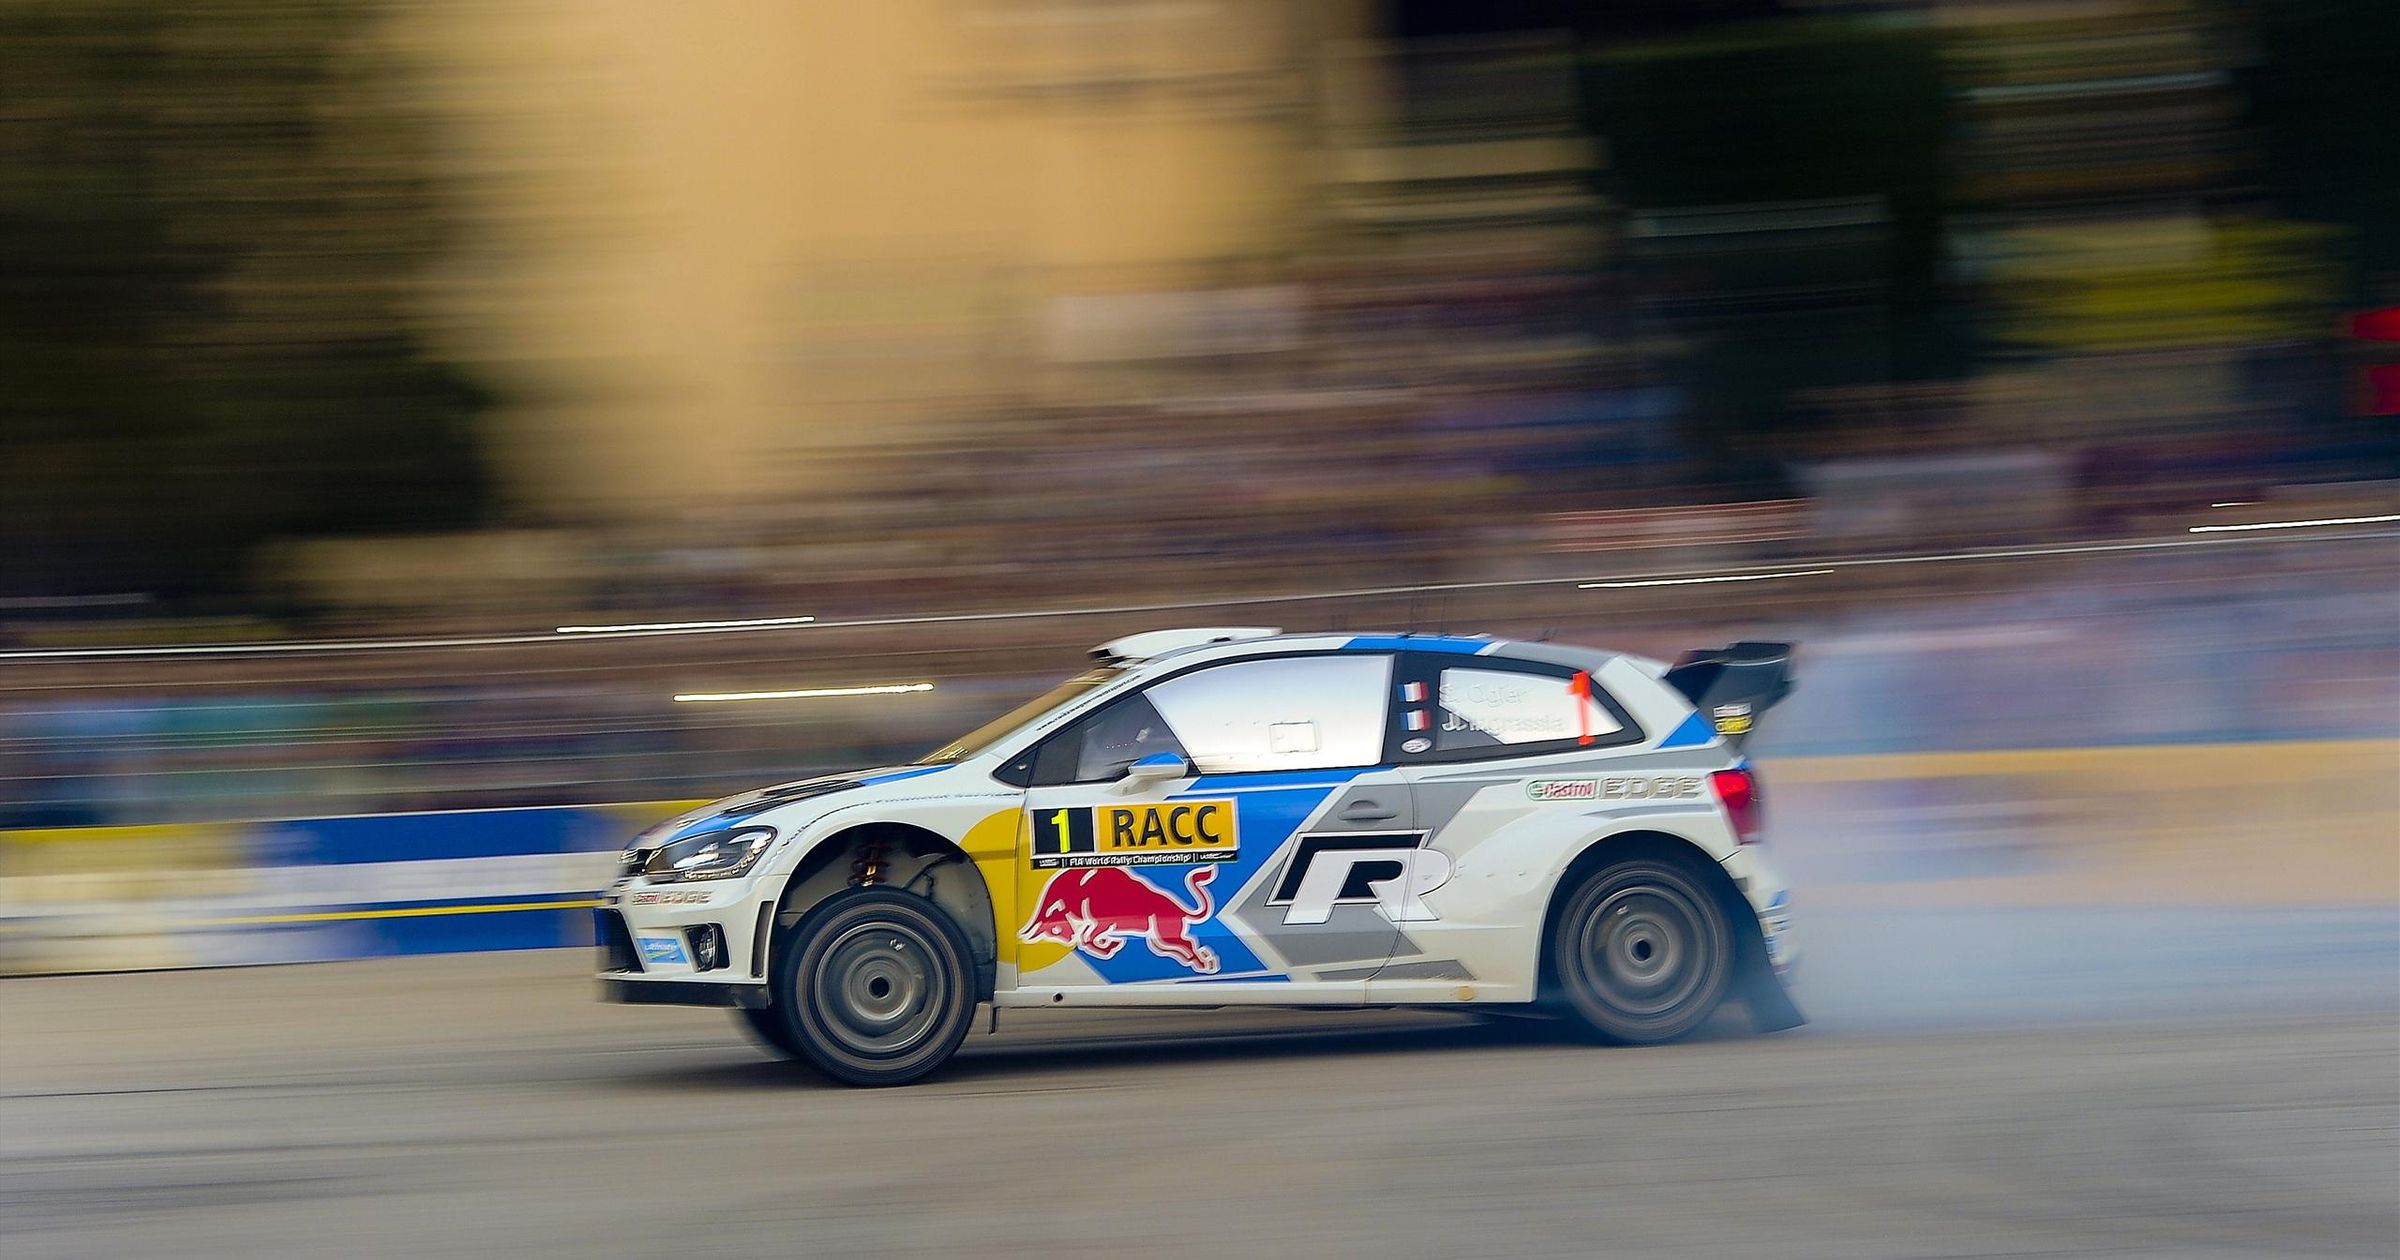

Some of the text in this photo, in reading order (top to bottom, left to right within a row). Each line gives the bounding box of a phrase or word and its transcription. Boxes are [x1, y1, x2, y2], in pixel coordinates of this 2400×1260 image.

[1566, 669, 1597, 746] 1
[1601, 777, 1705, 800] EDGE
[1052, 805, 1220, 854] 1 RACC
